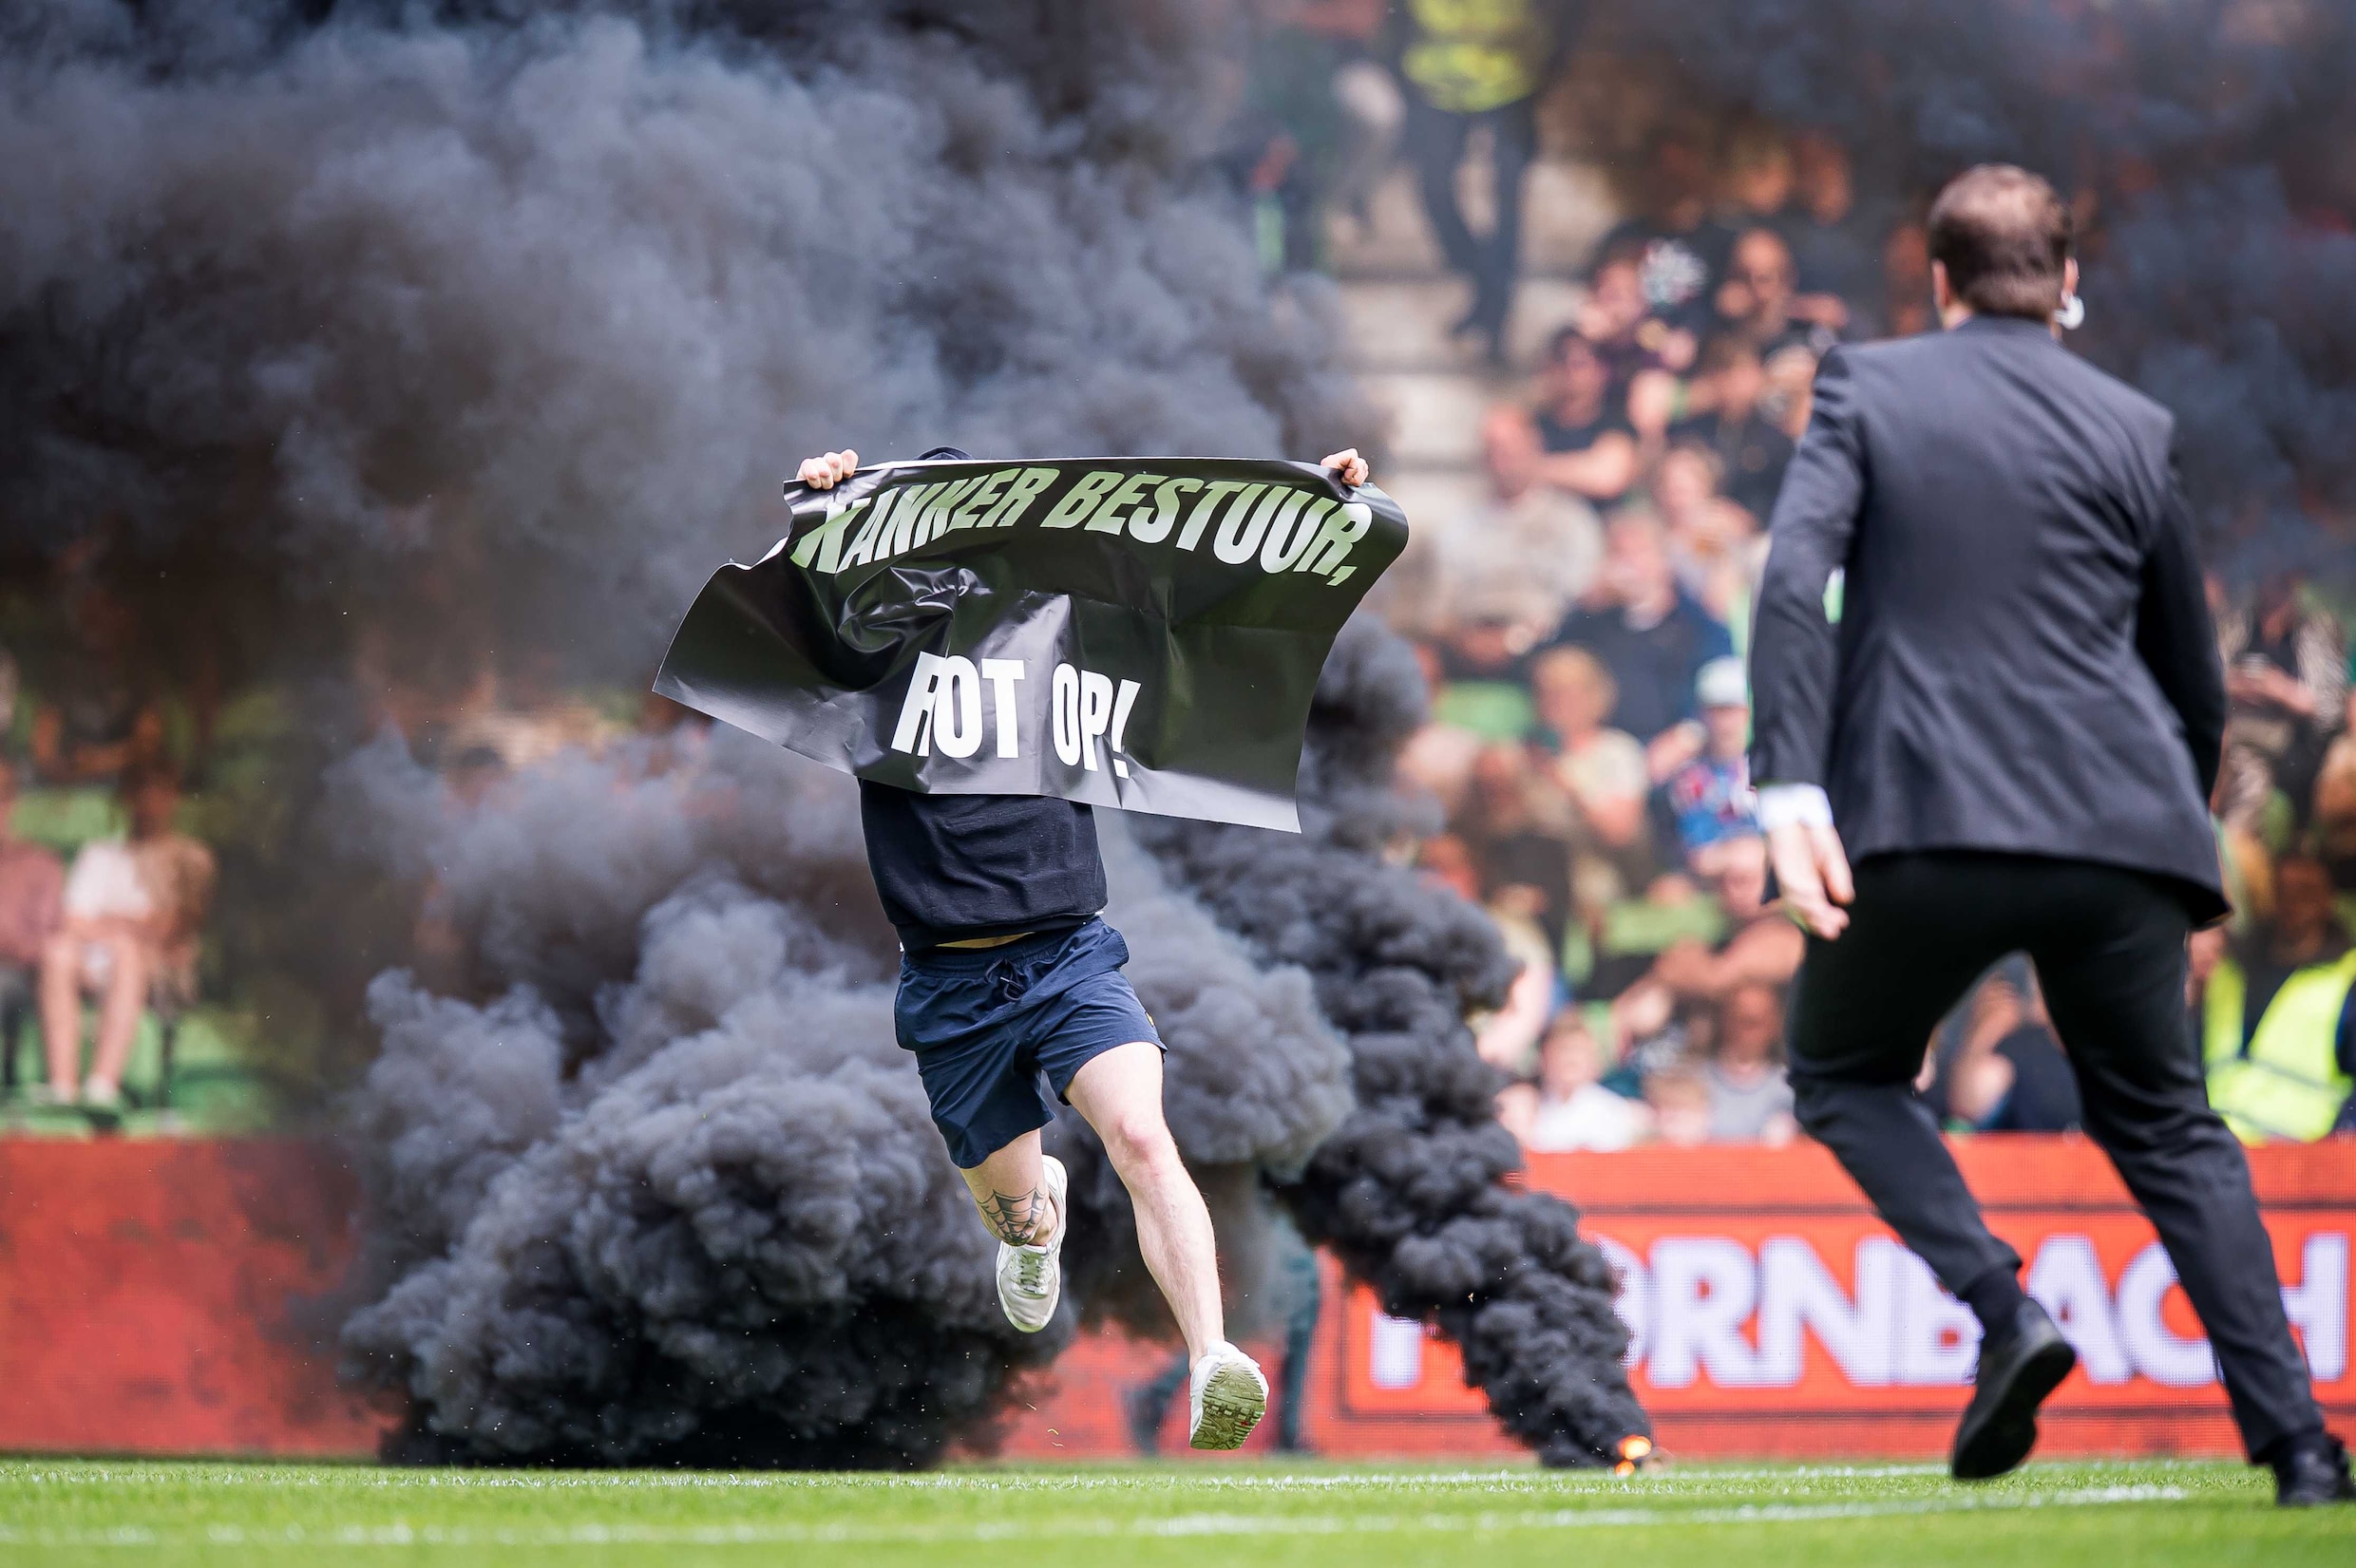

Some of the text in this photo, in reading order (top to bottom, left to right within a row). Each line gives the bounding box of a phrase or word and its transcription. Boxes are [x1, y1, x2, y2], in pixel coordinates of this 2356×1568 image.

[789, 467, 1373, 587] KANKER BESTUUR,
[891, 651, 1142, 780] ROT OP!
